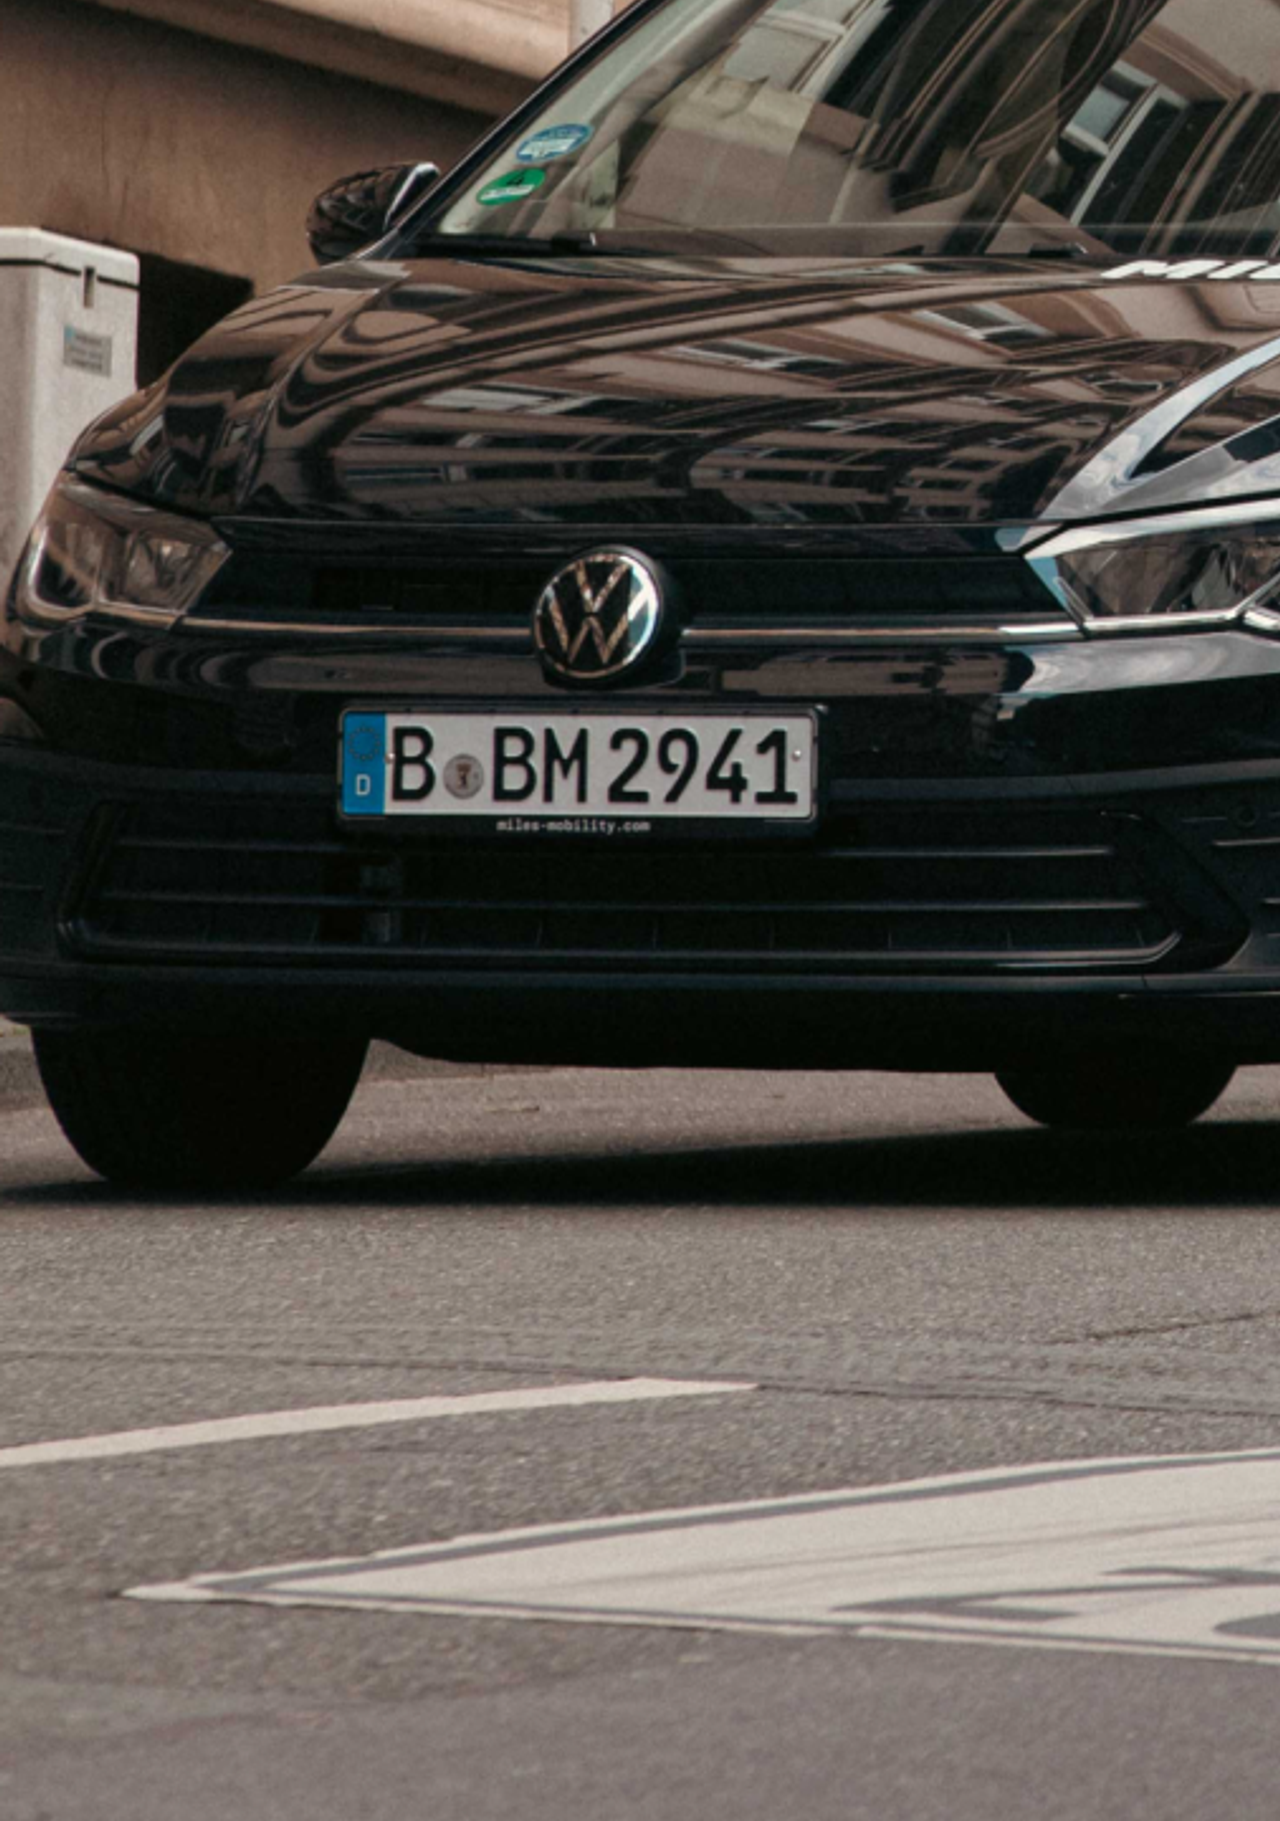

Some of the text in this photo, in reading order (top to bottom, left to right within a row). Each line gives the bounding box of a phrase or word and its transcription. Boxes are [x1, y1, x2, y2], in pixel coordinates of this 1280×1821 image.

[392, 726, 798, 805] B BM 2941
[355, 773, 371, 797] D
[496, 818, 652, 835] miles-mobility.com
